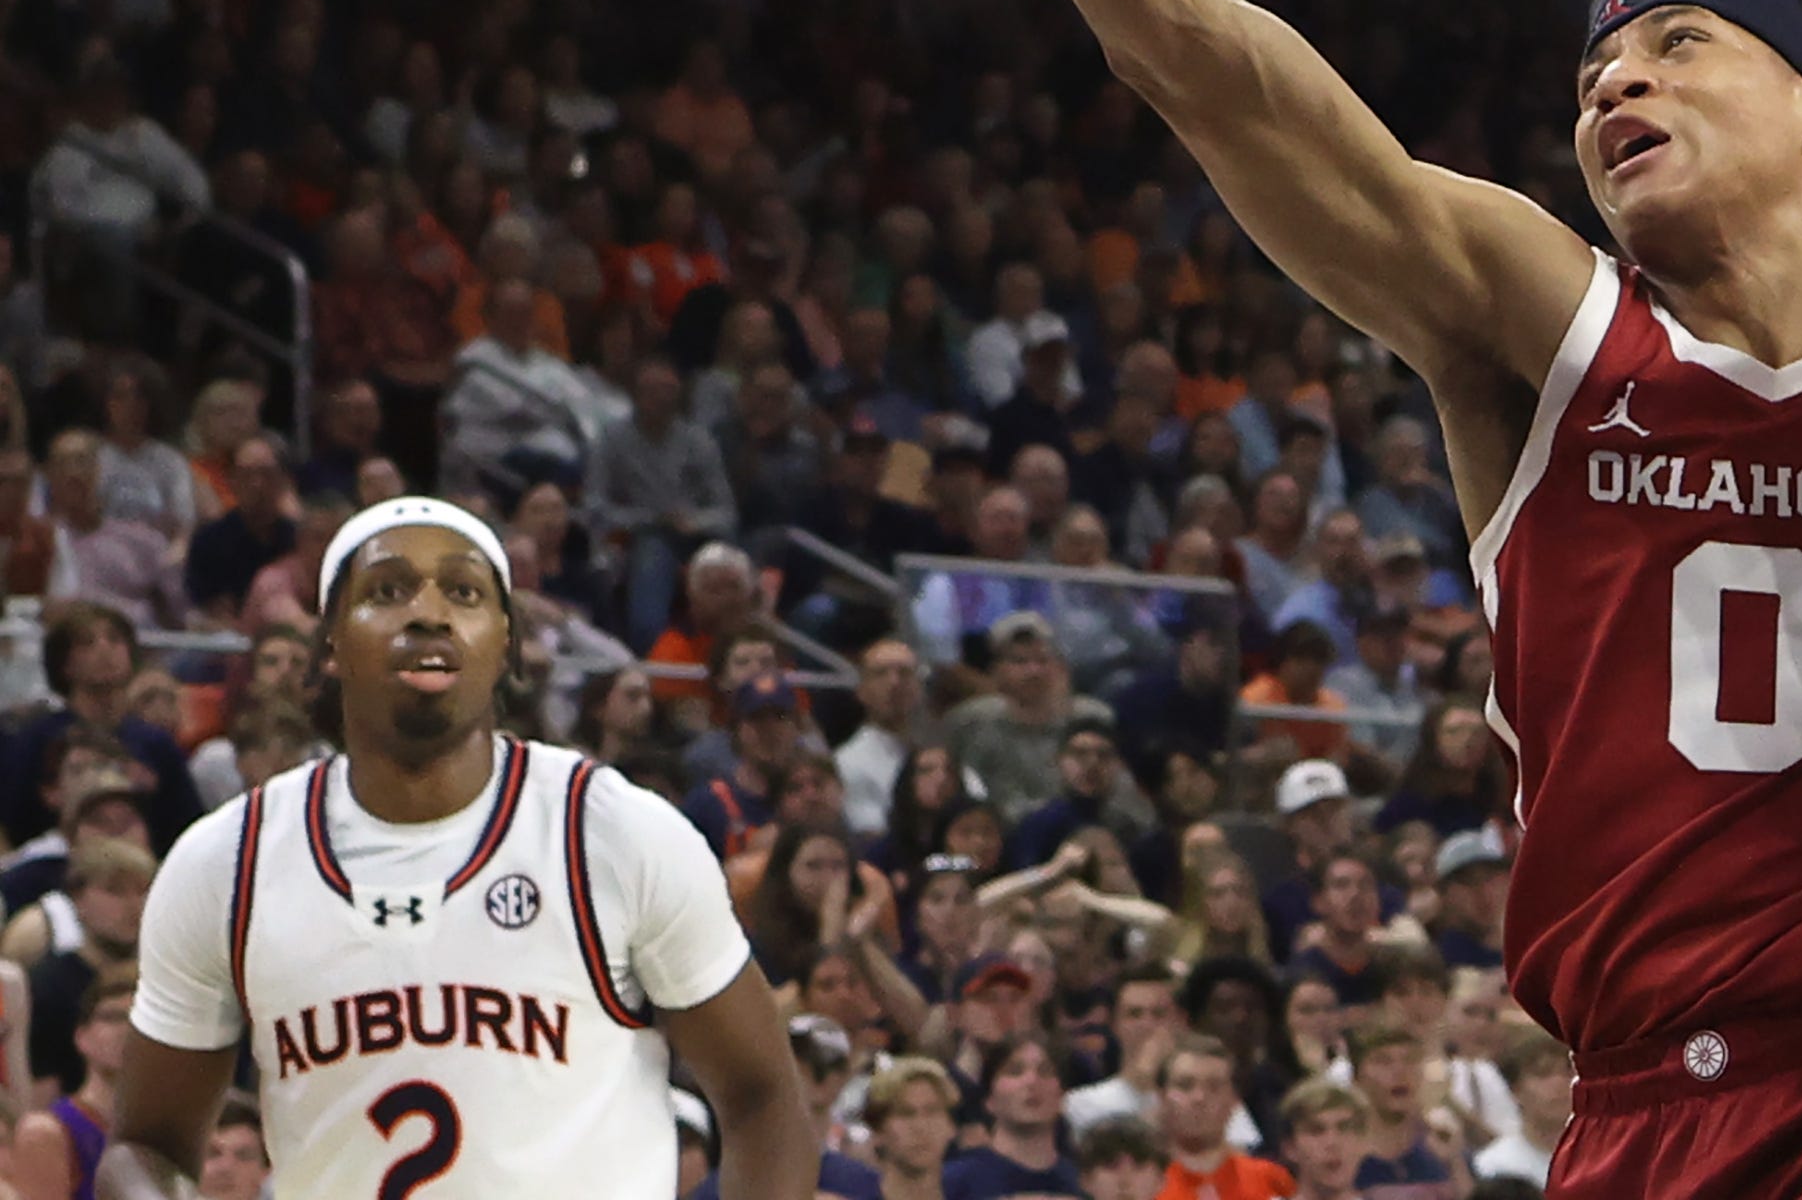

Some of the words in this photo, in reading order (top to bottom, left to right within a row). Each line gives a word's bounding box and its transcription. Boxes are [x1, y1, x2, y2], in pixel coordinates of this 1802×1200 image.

[488, 876, 539, 927] SEC
[275, 983, 570, 1078] AUBURN
[368, 1079, 462, 1200] 2
